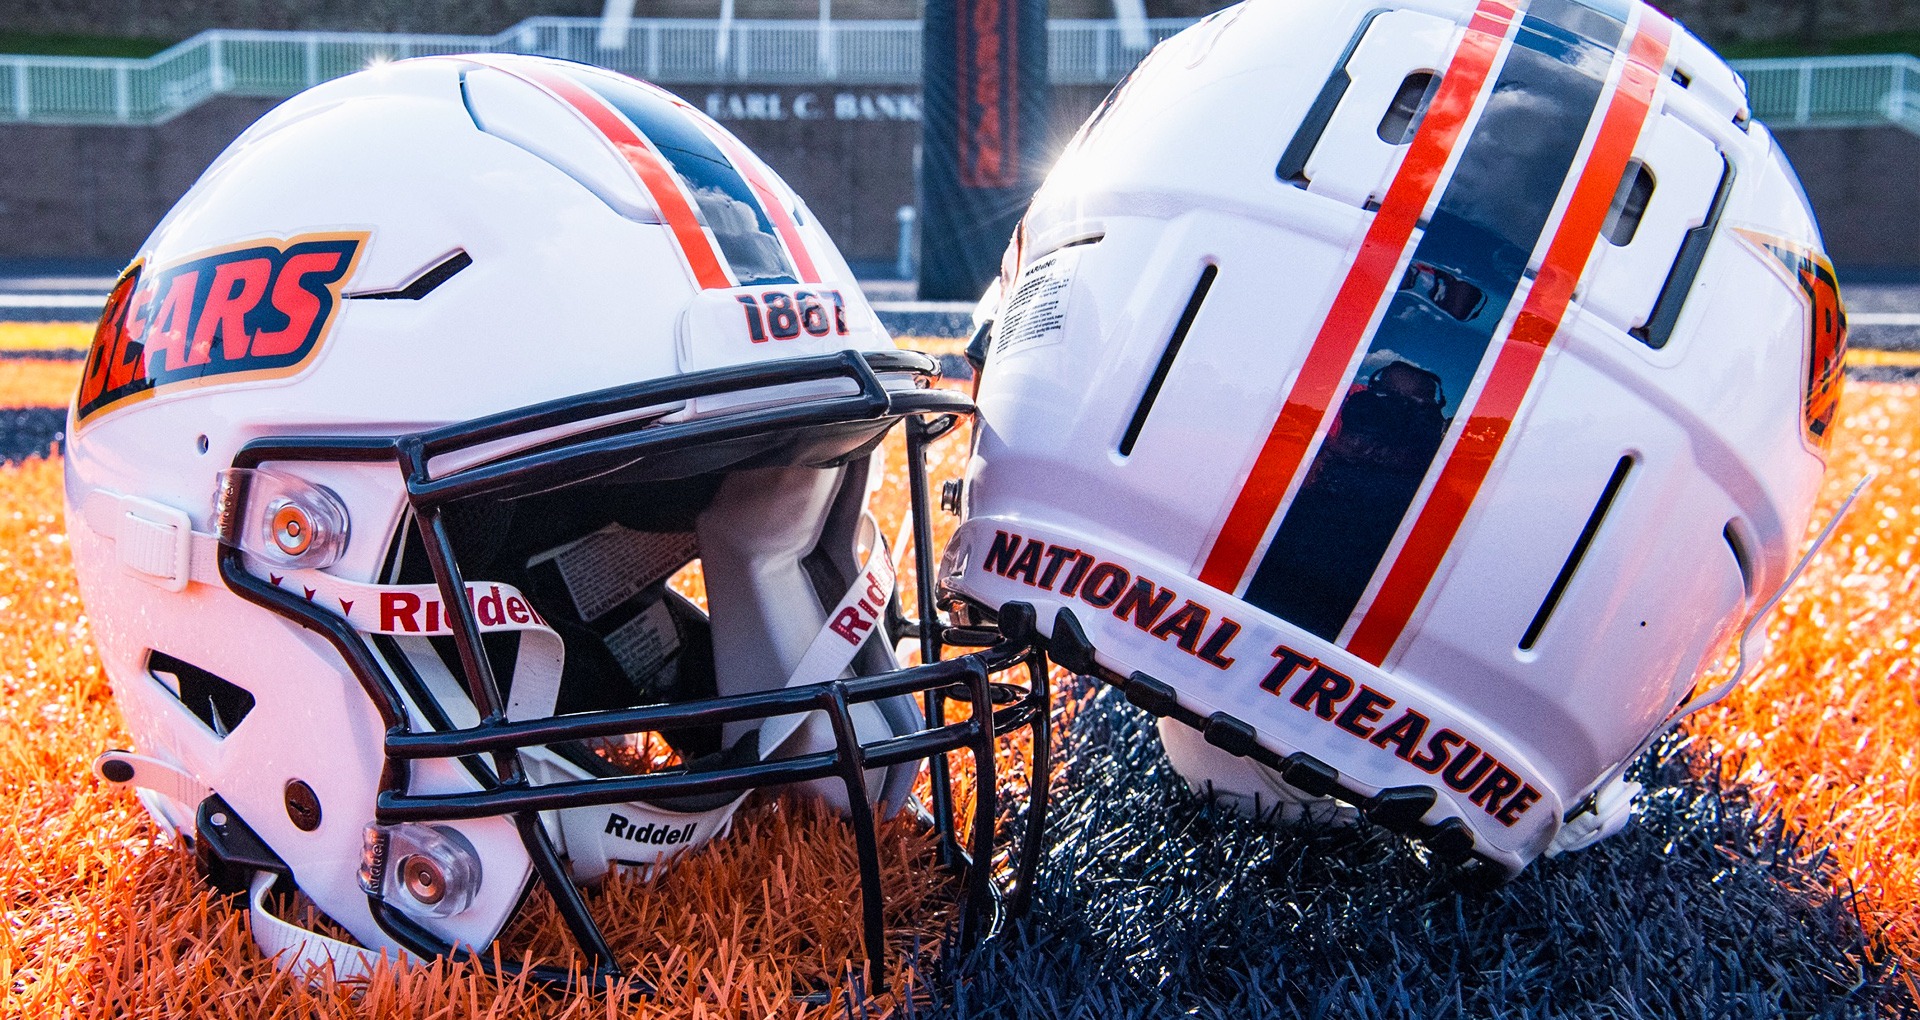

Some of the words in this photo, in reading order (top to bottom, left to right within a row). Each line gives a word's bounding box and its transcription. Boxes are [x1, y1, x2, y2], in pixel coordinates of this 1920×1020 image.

[78, 250, 343, 412] BEARS
[735, 289, 850, 343] 1867
[380, 586, 548, 632] Ridel
[983, 530, 1242, 671] NATIONAL
[1259, 644, 1543, 828] TREASURE
[605, 813, 698, 845] Riddell
